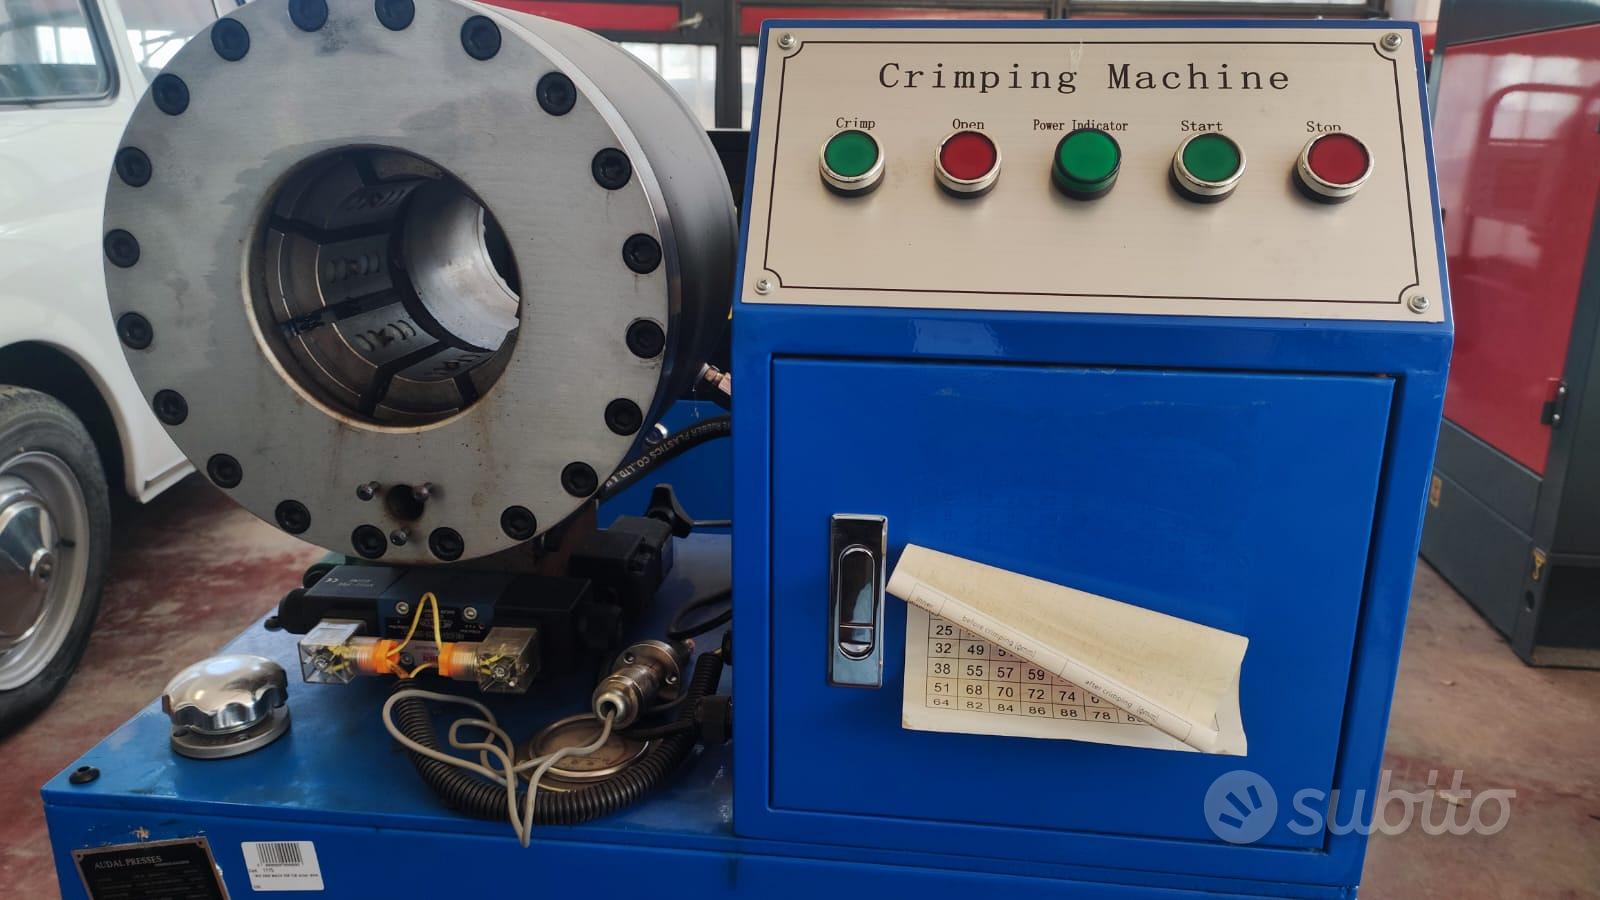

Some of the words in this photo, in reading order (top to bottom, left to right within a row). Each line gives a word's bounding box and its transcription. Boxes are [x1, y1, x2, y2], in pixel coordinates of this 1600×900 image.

[879, 62, 1078, 94] Crimping
[1107, 63, 1290, 90] Machine
[835, 116, 876, 131] Crimp
[952, 118, 985, 130] Open
[1032, 118, 1065, 131] Power
[1071, 119, 1129, 132] Indicator
[1180, 119, 1224, 132] Start
[935, 625, 953, 636] 25
[935, 642, 952, 654] 32
[967, 644, 984, 656] 49
[934, 663, 951, 675] 38
[966, 665, 983, 677] 55
[997, 667, 1014, 679] 57
[1028, 669, 1045, 681] 59
[934, 682, 950, 694] 51
[966, 684, 983, 696] 68
[997, 686, 1014, 698] 70
[1028, 688, 1045, 700] 72
[1059, 690, 1076, 702] 74
[933, 698, 949, 707] 64
[966, 701, 984, 710] 82
[997, 703, 1014, 713] 84
[1028, 706, 1046, 716] 86
[1060, 708, 1078, 718] 88
[1094, 711, 1111, 720] 78
[125, 855, 163, 866] PRESSES
